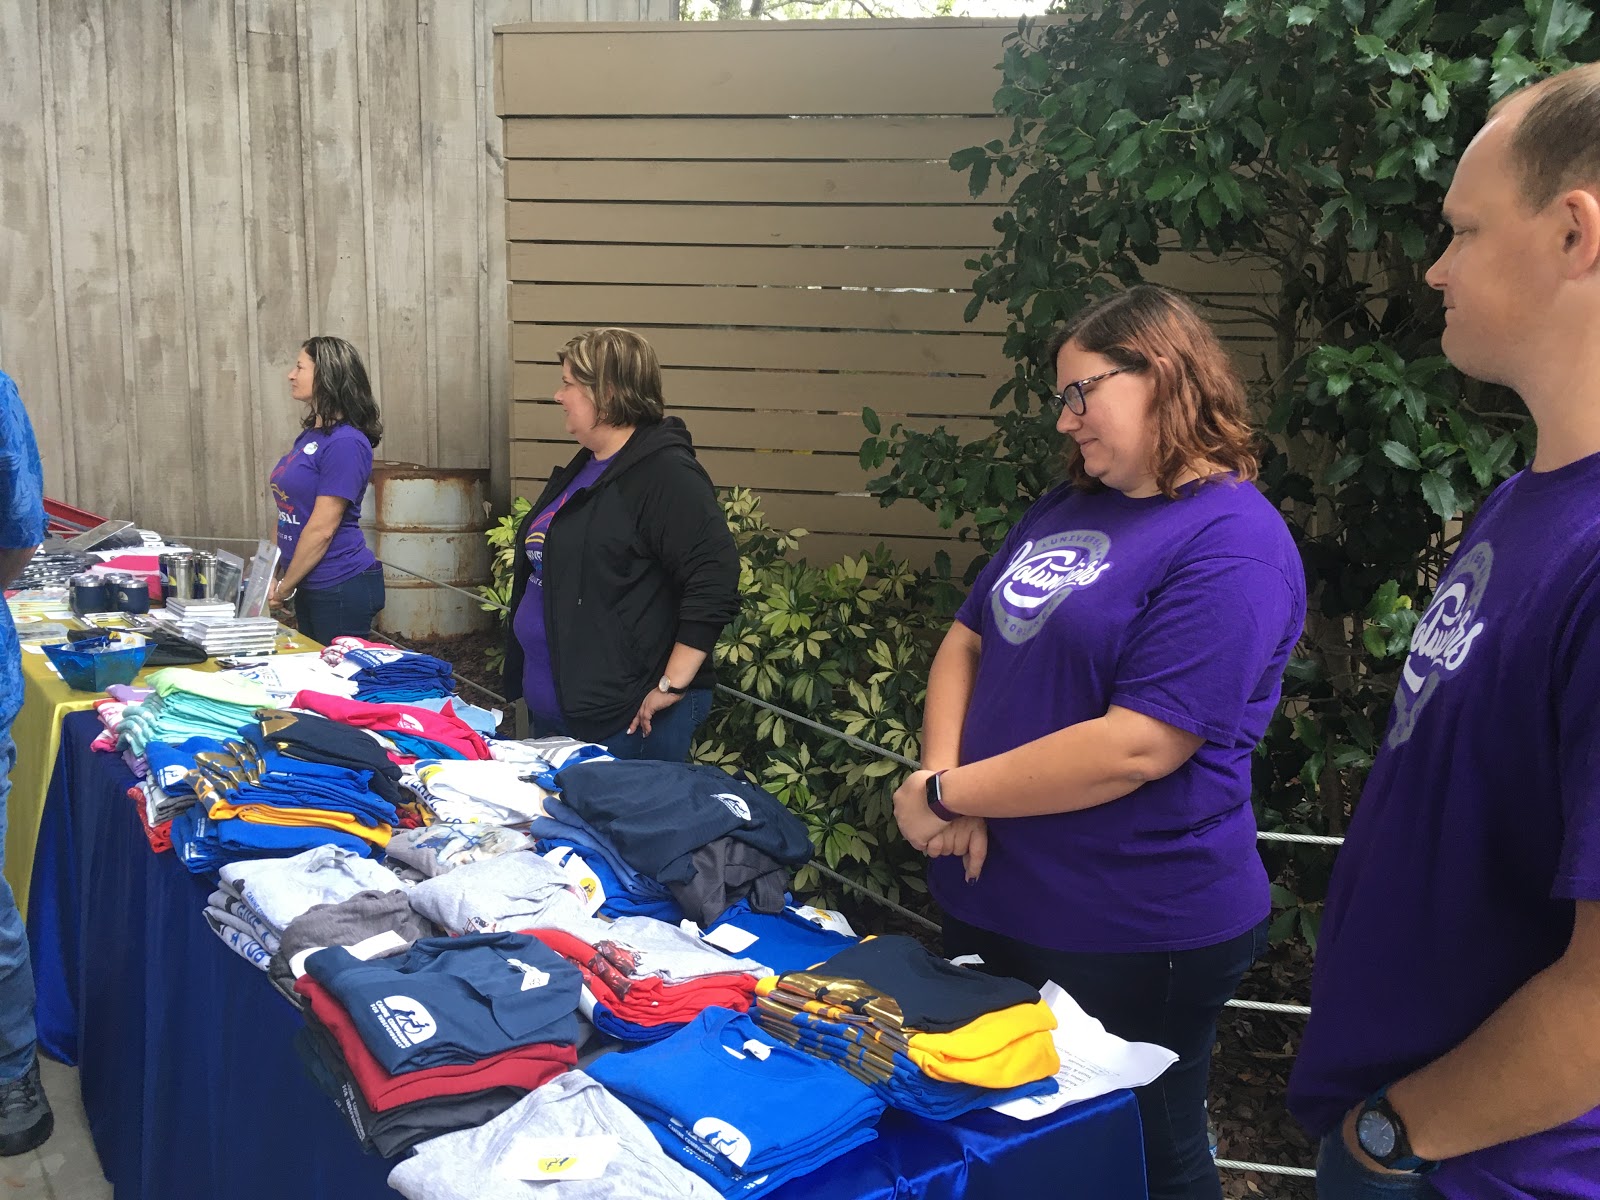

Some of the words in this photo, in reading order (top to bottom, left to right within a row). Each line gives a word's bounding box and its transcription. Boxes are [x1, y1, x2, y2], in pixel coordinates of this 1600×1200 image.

[369, 1003, 380, 1014] FOR
[375, 1000, 391, 1018] CANINE
[387, 1017, 413, 1048] COMPANIONS
[667, 1123, 685, 1140] CANINE
[684, 1136, 716, 1162] COMPANIONS
